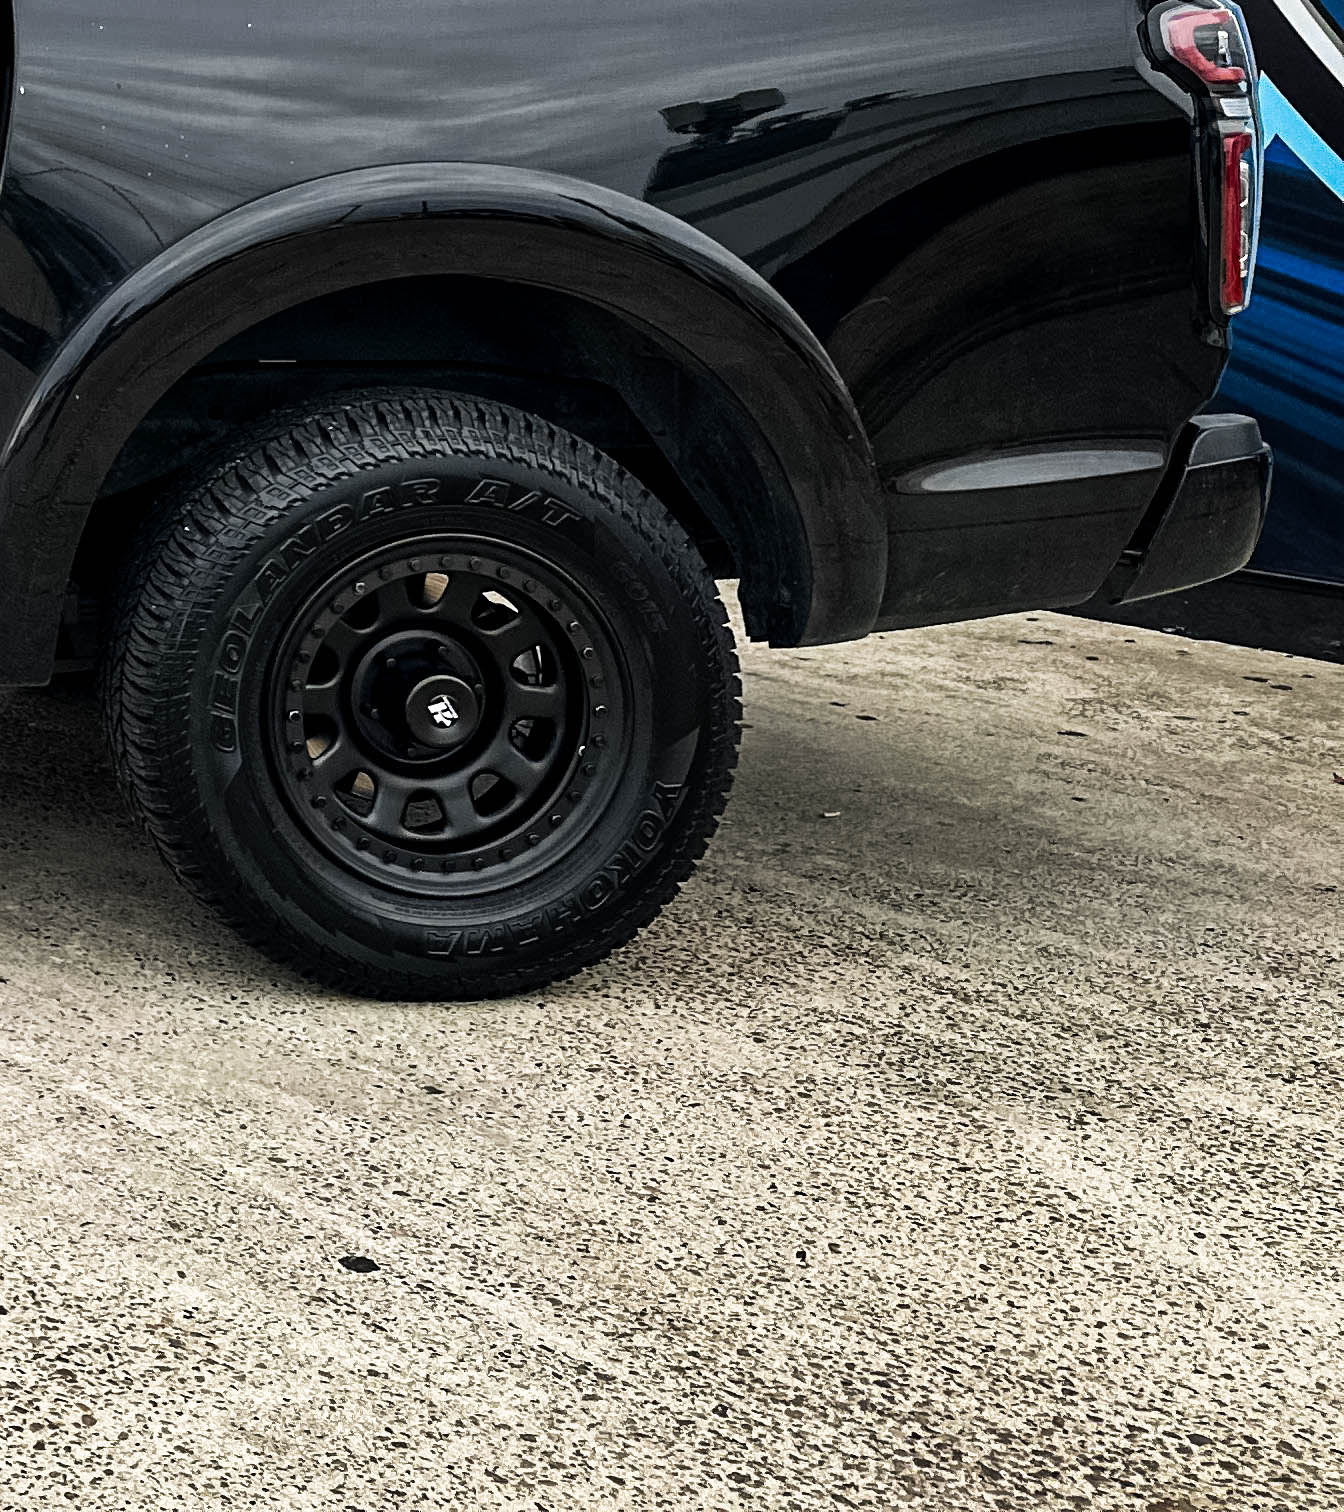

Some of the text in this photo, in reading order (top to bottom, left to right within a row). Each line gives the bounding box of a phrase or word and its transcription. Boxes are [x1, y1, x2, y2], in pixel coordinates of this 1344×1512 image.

[210, 477, 442, 755] GEOLANDAR
[465, 477, 587, 528] A/T
[424, 779, 686, 957] YOKOHAMA
